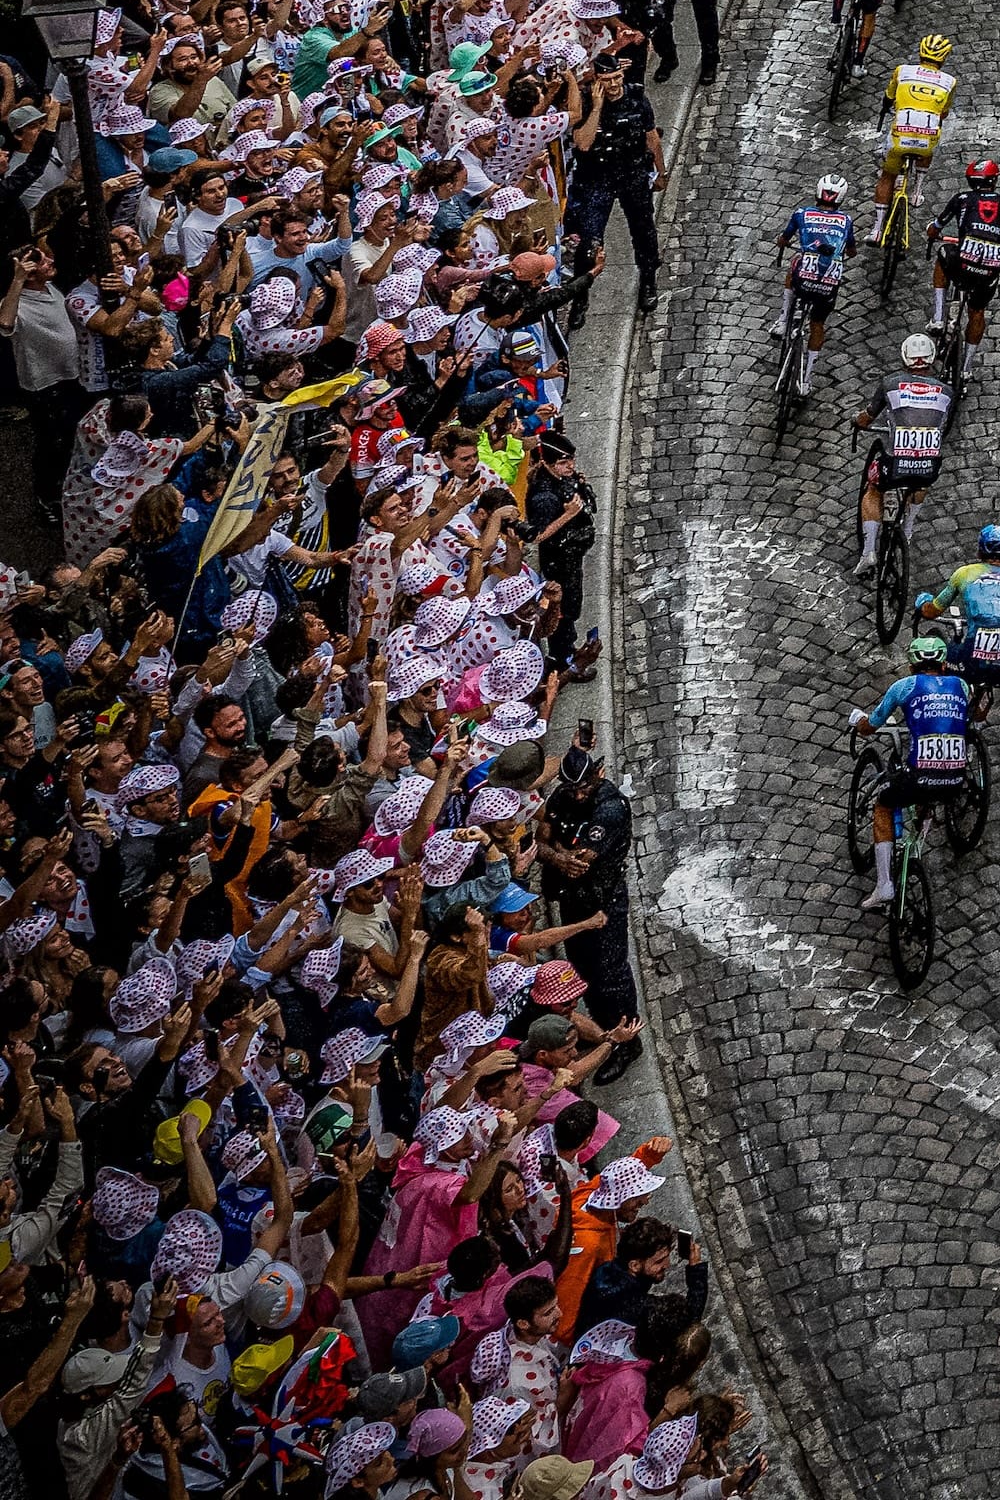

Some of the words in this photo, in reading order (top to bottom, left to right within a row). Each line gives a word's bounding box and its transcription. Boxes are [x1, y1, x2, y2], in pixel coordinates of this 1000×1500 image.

[912, 85, 936, 96] LCL
[905, 110, 911, 126] 1
[926, 114, 931, 129] 1
[805, 216, 845, 228] SOUDAL
[964, 239, 983, 256] 118
[805, 256, 818, 273] 25
[904, 384, 937, 394] Alpecin
[895, 430, 917, 449] 103
[919, 430, 940, 449] 103
[358, 429, 370, 464] ARKEA
[894, 449, 916, 457] VELUX
[975, 632, 999, 652] 172
[972, 651, 997, 661] VELUX
[923, 703, 948, 711] AG2R
[949, 703, 960, 712] LA
[923, 710, 964, 720] MONDIALE
[919, 738, 944, 760] 158
[917, 760, 942, 769] VELUX
